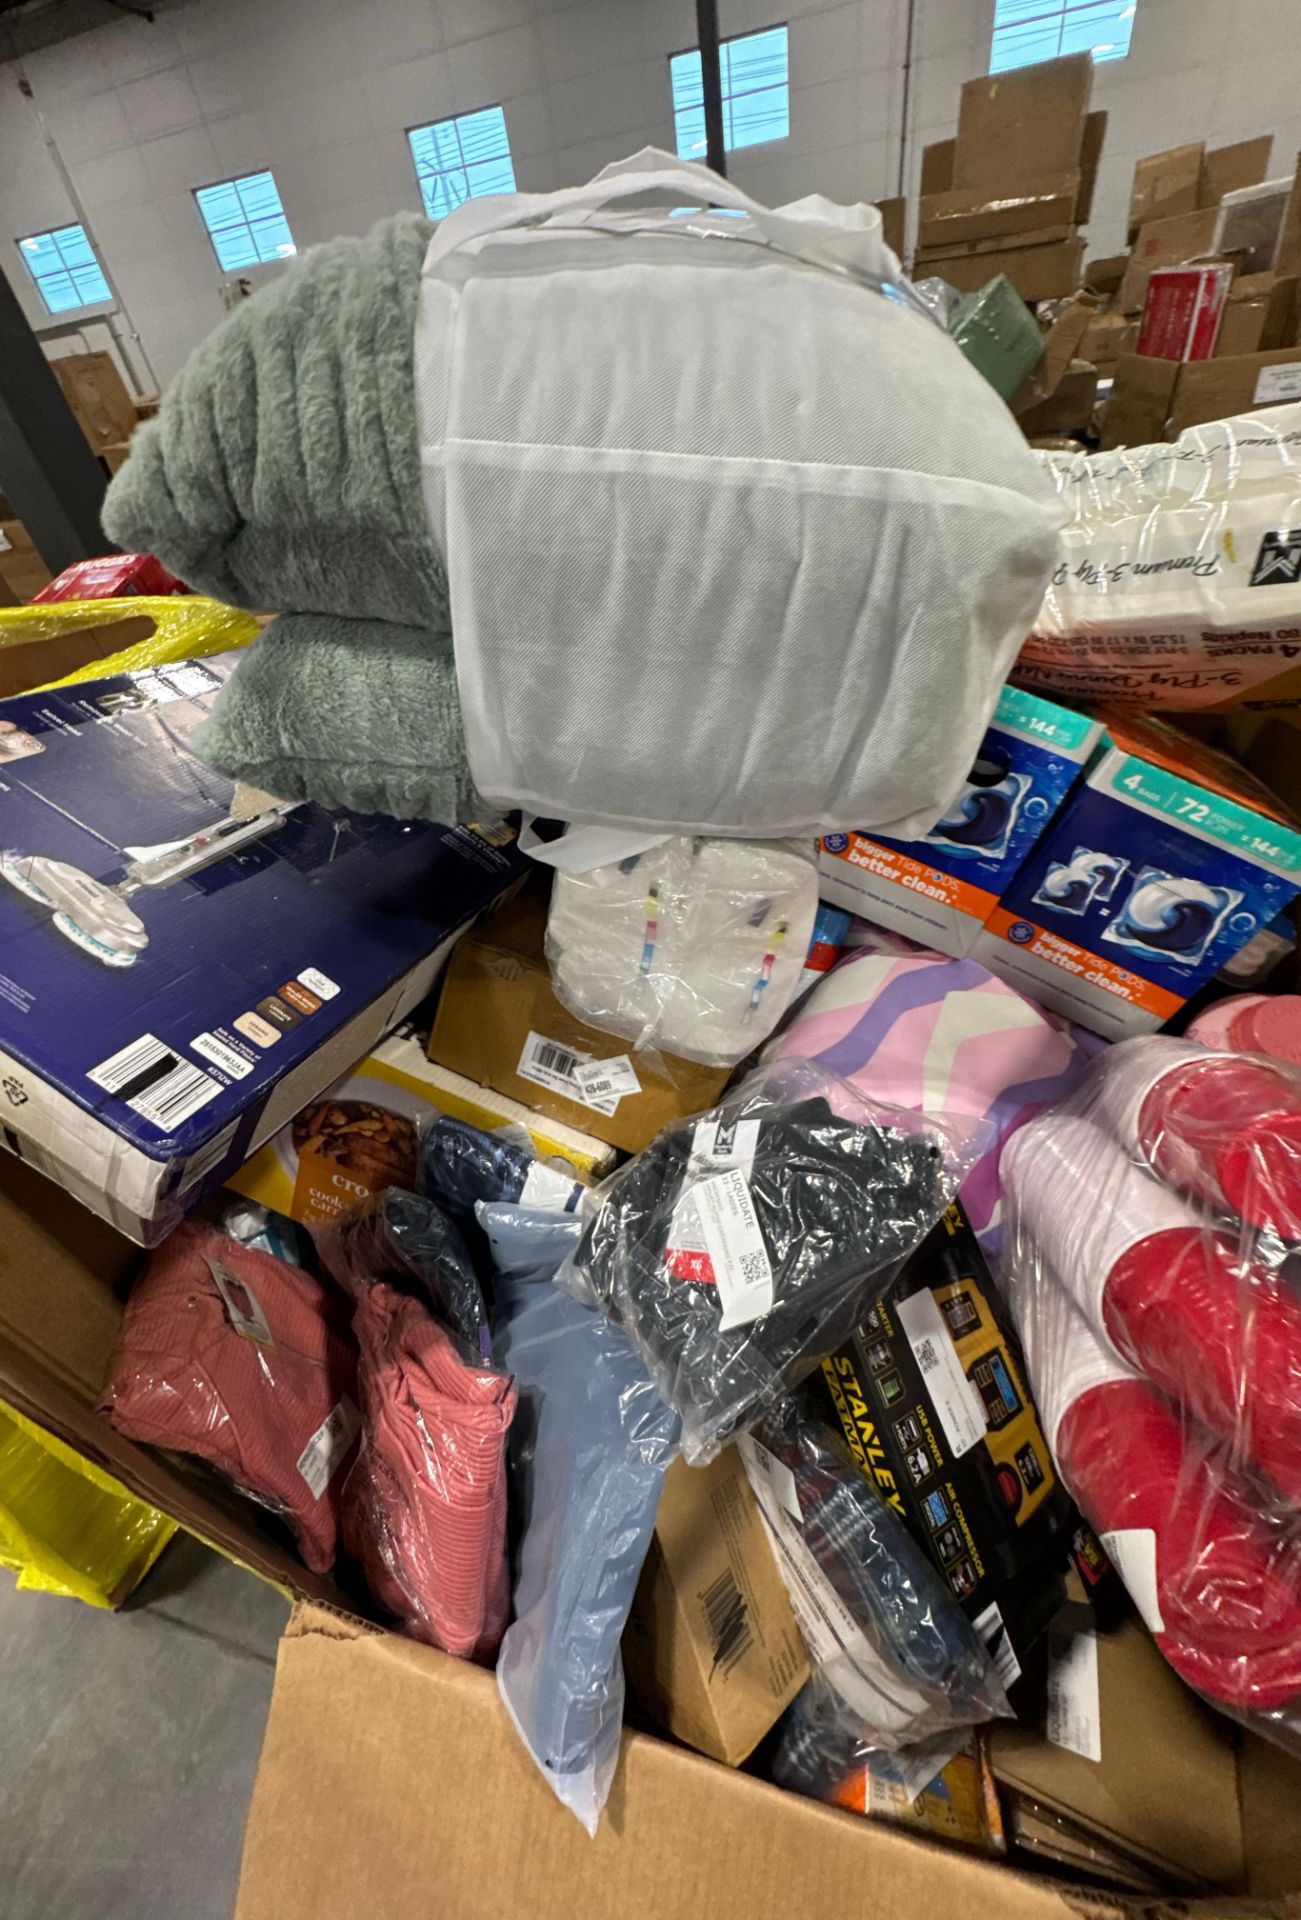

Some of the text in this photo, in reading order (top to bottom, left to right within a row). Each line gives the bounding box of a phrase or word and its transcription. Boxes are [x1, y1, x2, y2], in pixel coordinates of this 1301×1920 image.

[1132, 555, 1220, 577] Premium
[1208, 643, 1301, 658] 4 PACKS
[1149, 671, 1242, 689] 3-Ply
[1029, 717, 1056, 736] 144
[1123, 774, 1144, 790] 4
[1175, 797, 1211, 823] 72
[854, 837, 895, 862] bigger
[897, 856, 923, 874] Tide
[1250, 837, 1281, 857] 144
[847, 850, 901, 880] better
[1031, 941, 1085, 975] better
[1039, 931, 1082, 957] bigger
[1082, 951, 1110, 971] Tide
[730, 1172, 755, 1230] LIQUIDATE
[876, 1300, 895, 1338] TARTER
[824, 1368, 872, 1470] FATMA
[835, 1355, 907, 1517] STANLEY
[915, 1404, 944, 1468] USB POWER
[905, 1457, 921, 1485] 6.2A
[944, 1481, 986, 1578] AIR COMPRESSOR
